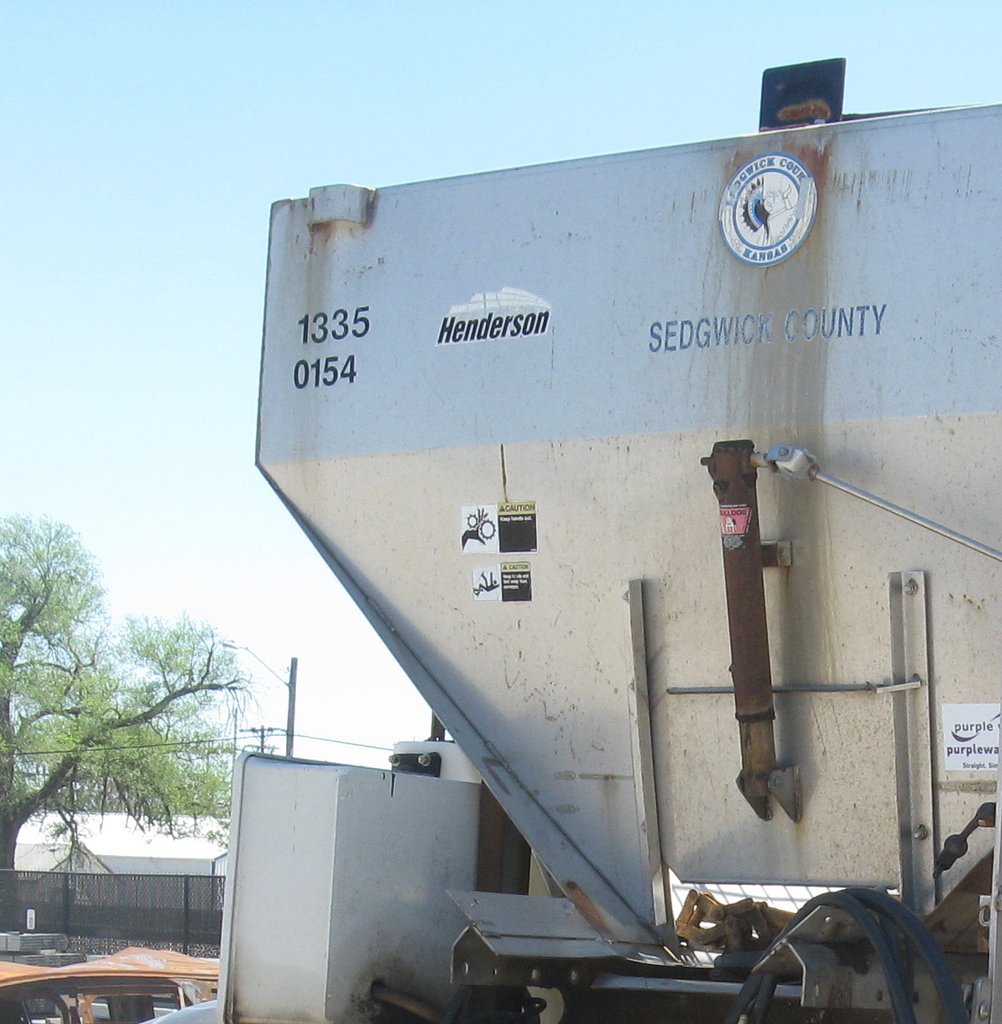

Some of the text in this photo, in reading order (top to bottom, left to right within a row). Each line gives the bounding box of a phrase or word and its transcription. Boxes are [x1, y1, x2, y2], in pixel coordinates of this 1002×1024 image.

[742, 243, 789, 261] KANSAS
[298, 306, 370, 344] 1335
[437, 310, 551, 344] Henderson
[649, 304, 887, 352] SEDGWICK COUNTY
[293, 355, 357, 389] 0154
[506, 503, 535, 512] CAUTION
[954, 721, 994, 733] purple
